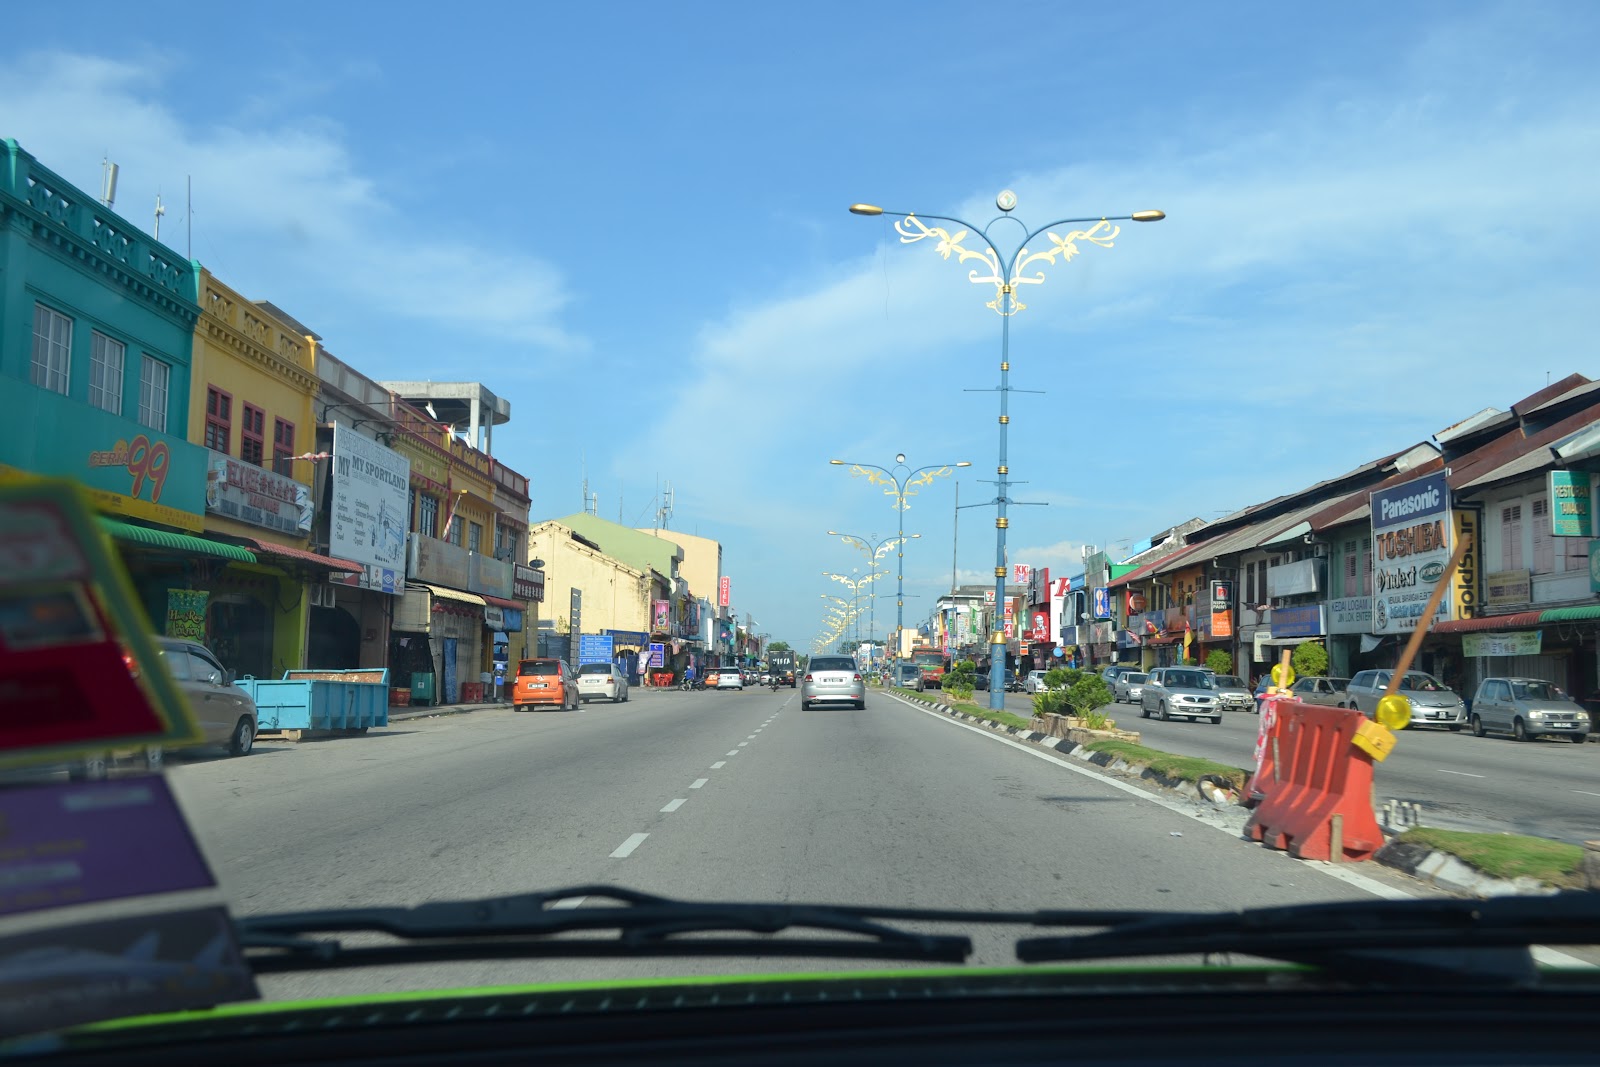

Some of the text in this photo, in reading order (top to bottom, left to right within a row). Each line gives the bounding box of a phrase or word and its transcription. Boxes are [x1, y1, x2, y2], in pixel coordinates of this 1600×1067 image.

[128, 434, 170, 504] 99
[338, 455, 351, 478] MY
[352, 455, 365, 472] MY
[365, 462, 406, 491] SPORTLAND
[1381, 485, 1440, 521] Panasonic
[1376, 519, 1447, 562] TOSHIBA
[1331, 601, 1347, 612] KEDAI
[1348, 599, 1368, 610] LOGAM
